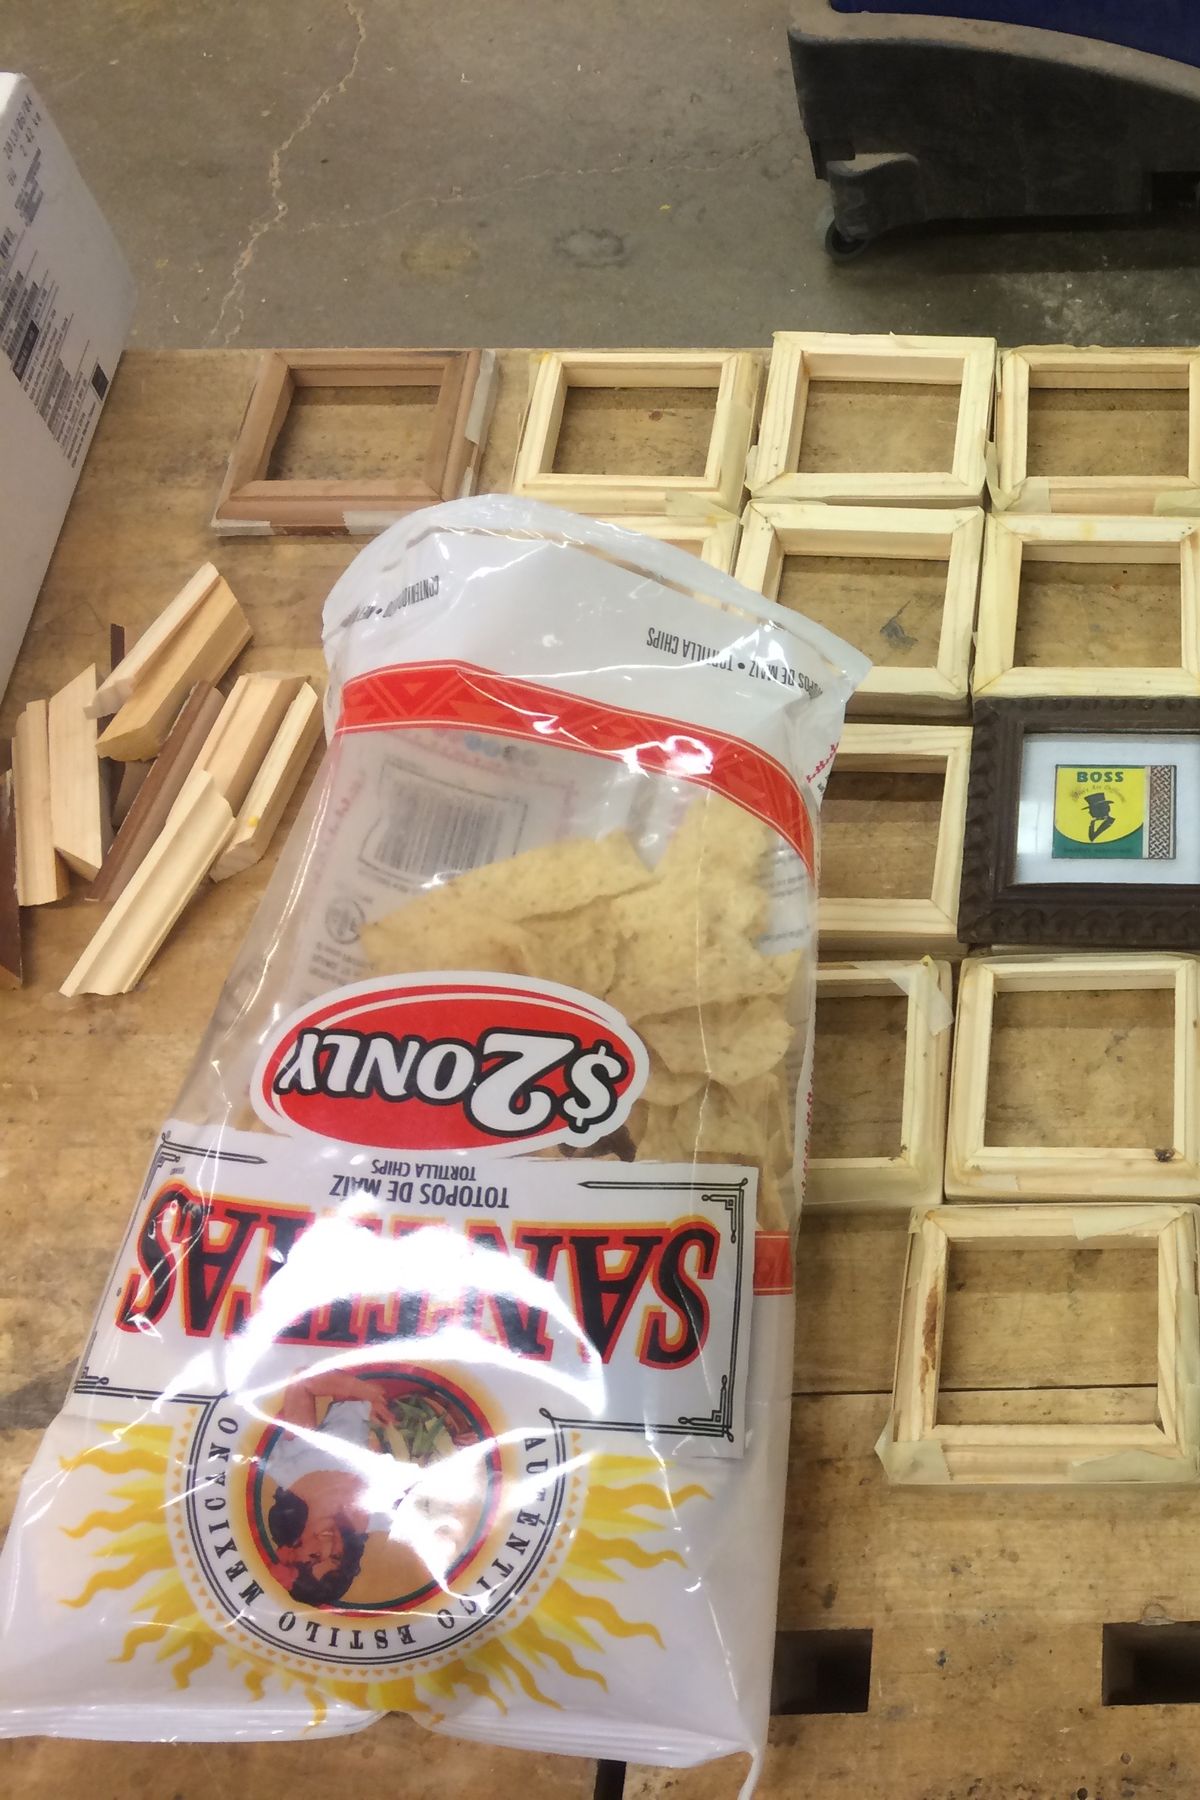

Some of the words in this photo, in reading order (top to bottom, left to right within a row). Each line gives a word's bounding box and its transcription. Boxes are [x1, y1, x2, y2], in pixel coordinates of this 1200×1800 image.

[646, 626, 680, 655] CHIPS
[781, 667, 796, 687] DE
[1076, 771, 1124, 783] BOSS
[275, 1028, 477, 1103] ONLY
[467, 1029, 627, 1135] $2
[372, 1159, 411, 1177] CHIPS
[416, 1162, 477, 1182] TORTILLA
[387, 1180, 413, 1203] DE
[419, 1182, 509, 1208] TOTOPOS
[204, 1416, 265, 1607] MEXICANO
[278, 1609, 417, 1650] ESTILO
